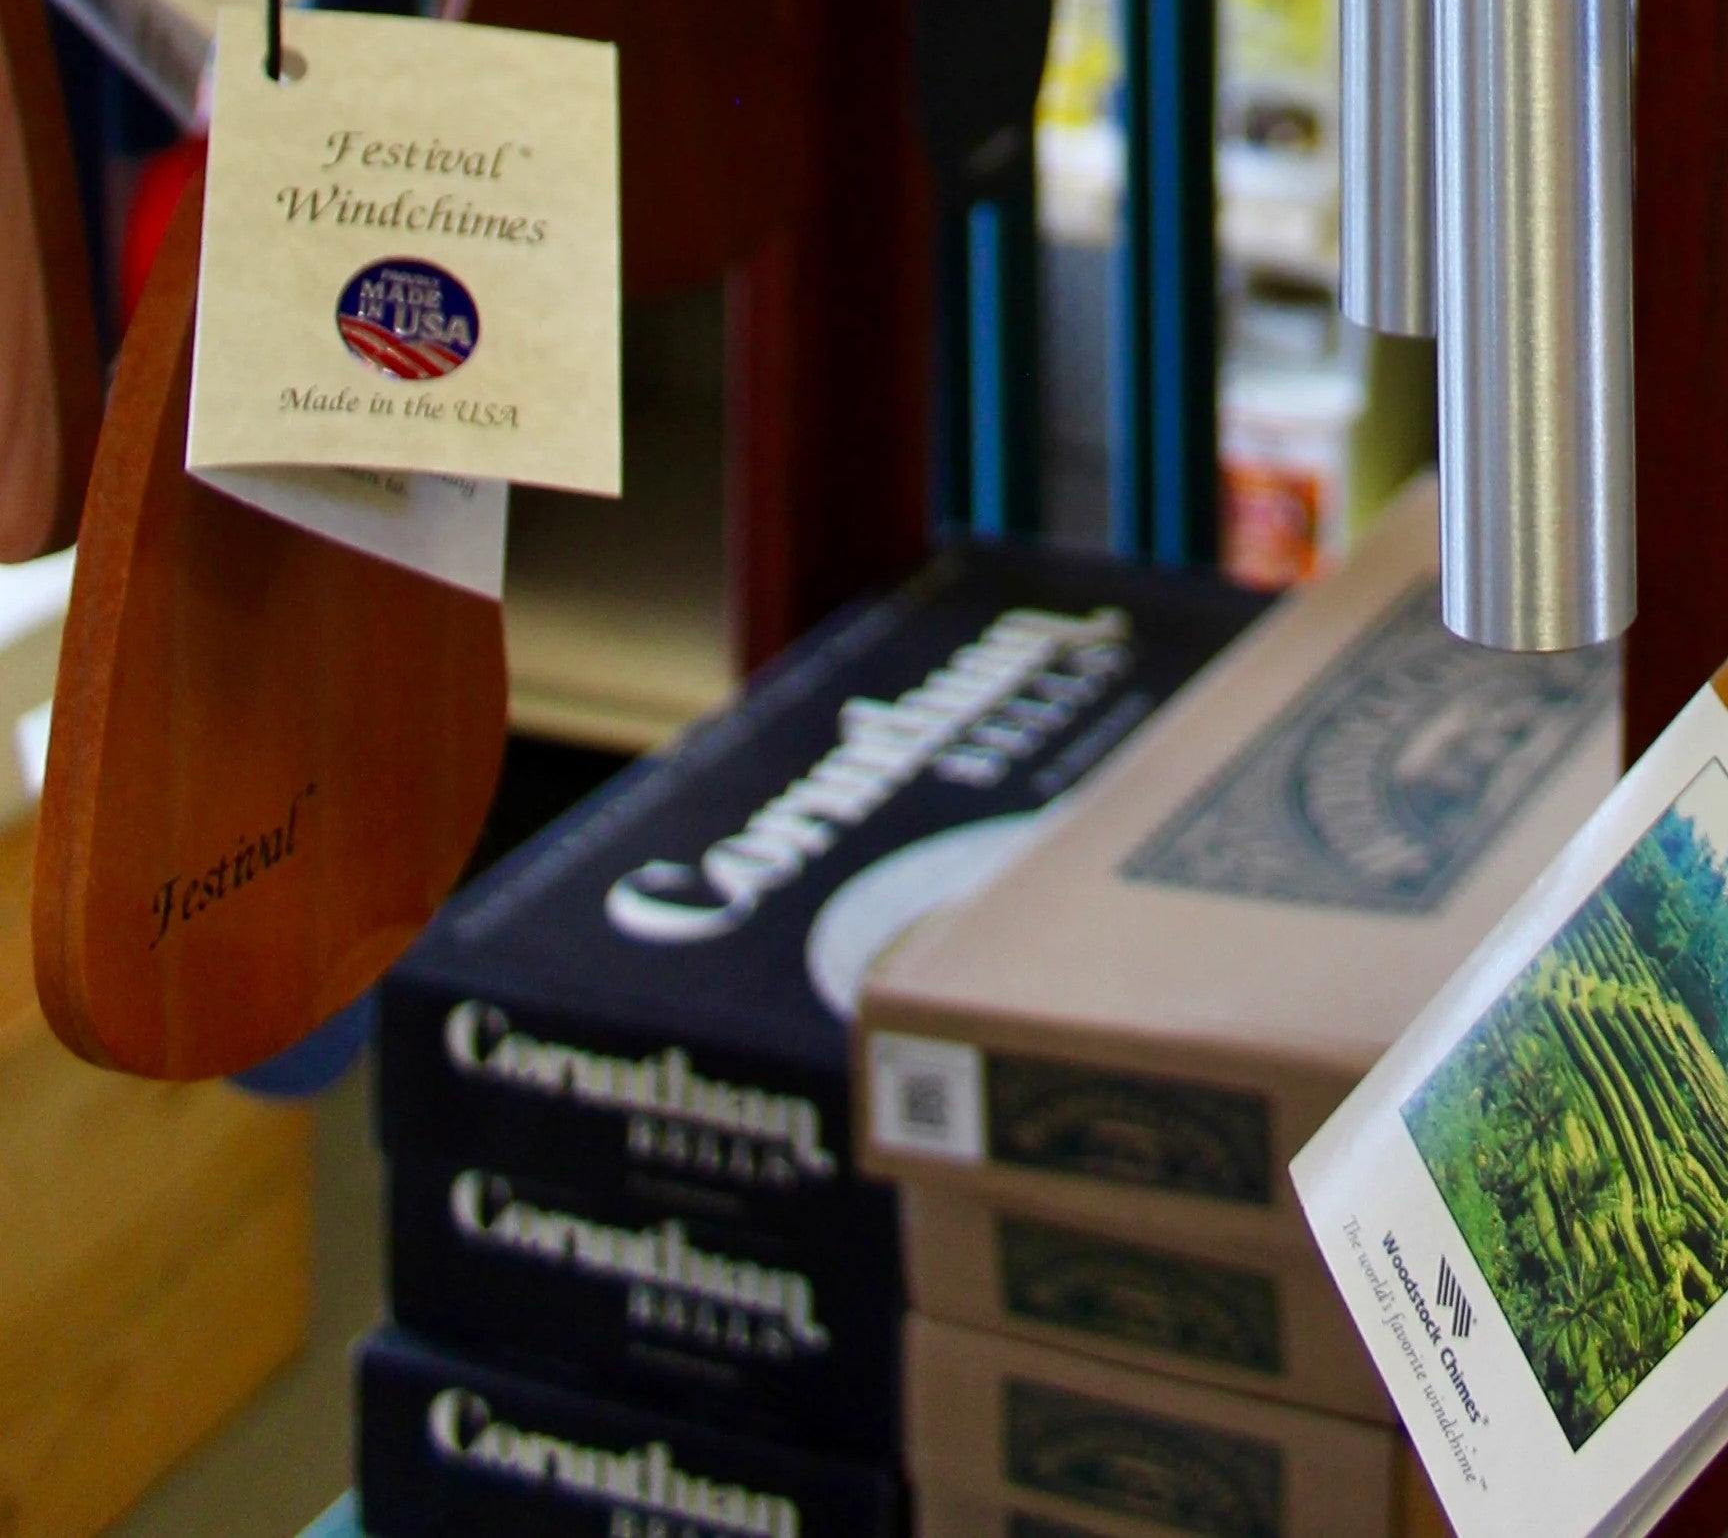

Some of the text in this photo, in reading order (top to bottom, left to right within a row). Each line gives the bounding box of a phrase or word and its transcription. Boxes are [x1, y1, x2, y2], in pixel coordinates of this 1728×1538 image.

[320, 128, 512, 180] Festival
[276, 185, 549, 246] Windchimes
[357, 298, 472, 347] IN USA
[359, 278, 443, 307] MADE
[279, 386, 520, 429] Made in the USA
[604, 606, 1132, 943] Corinthian
[444, 999, 836, 1180] Corinthian
[450, 1168, 830, 1354] Corinthian
[1382, 1229, 1443, 1347] Woodstock
[1342, 1214, 1478, 1483] The world's favorite windchime
